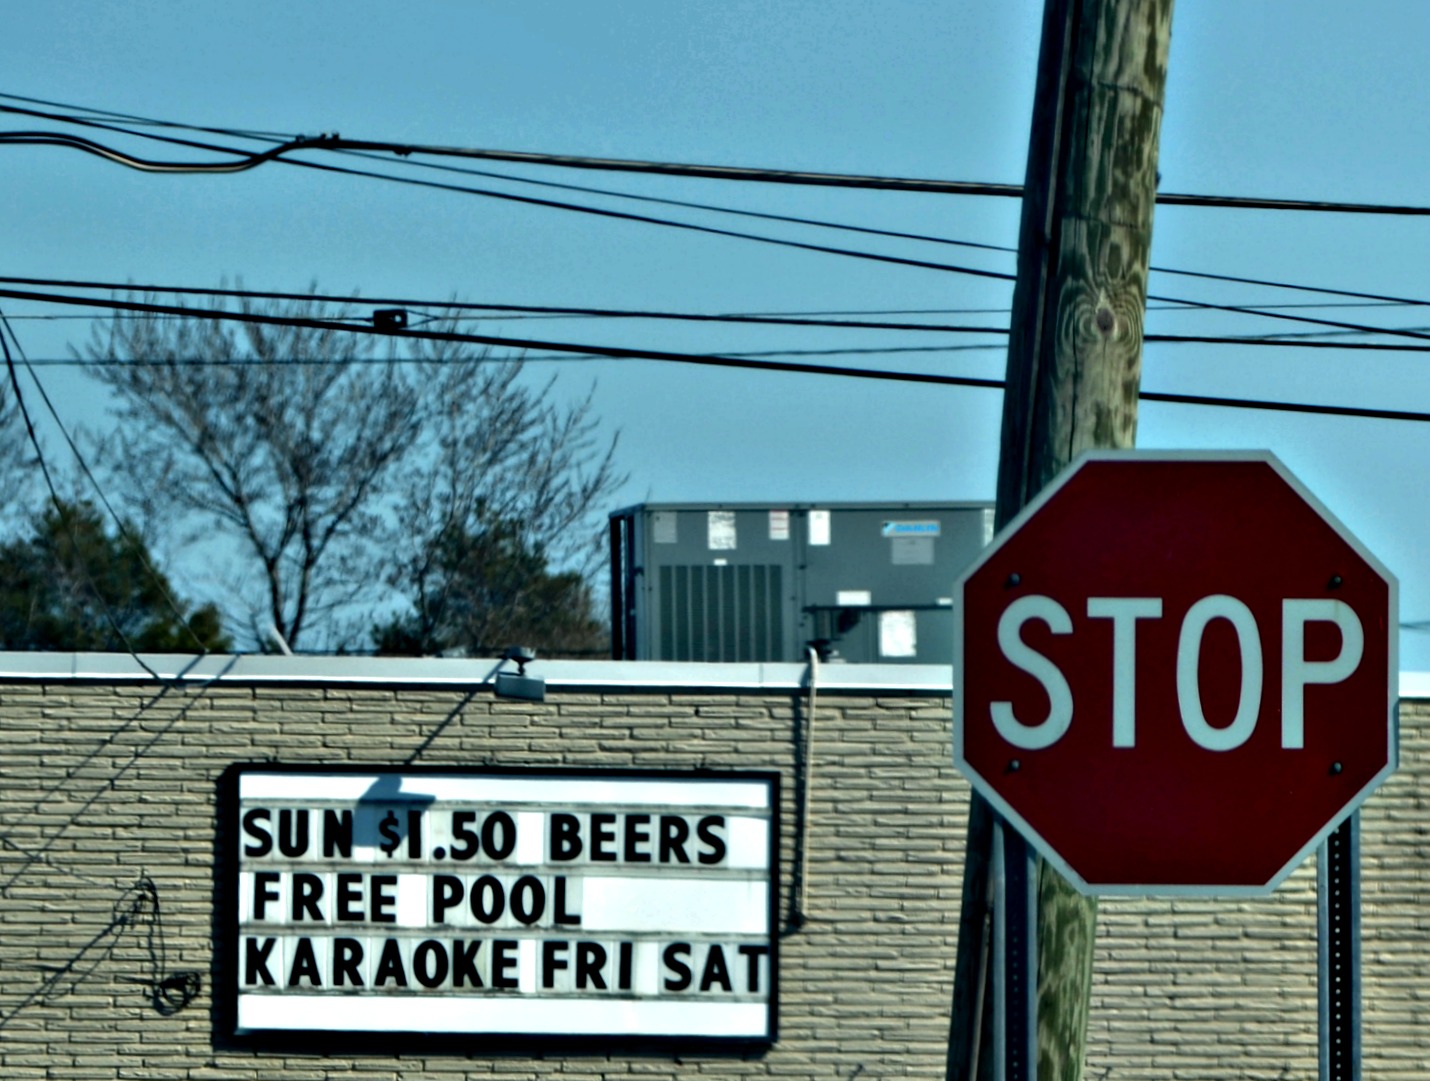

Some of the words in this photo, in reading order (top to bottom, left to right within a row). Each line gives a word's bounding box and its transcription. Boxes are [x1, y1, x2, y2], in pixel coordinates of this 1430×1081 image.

[990, 593, 1365, 752] STOP
[243, 808, 353, 858] SUN
[379, 810, 517, 861] $1.50
[550, 813, 727, 865] BEERS
[253, 872, 397, 923] FREE
[432, 875, 582, 926] POOL
[244, 936, 519, 988] KARAOKE
[542, 941, 632, 991] FRI
[662, 942, 769, 993] SAT
